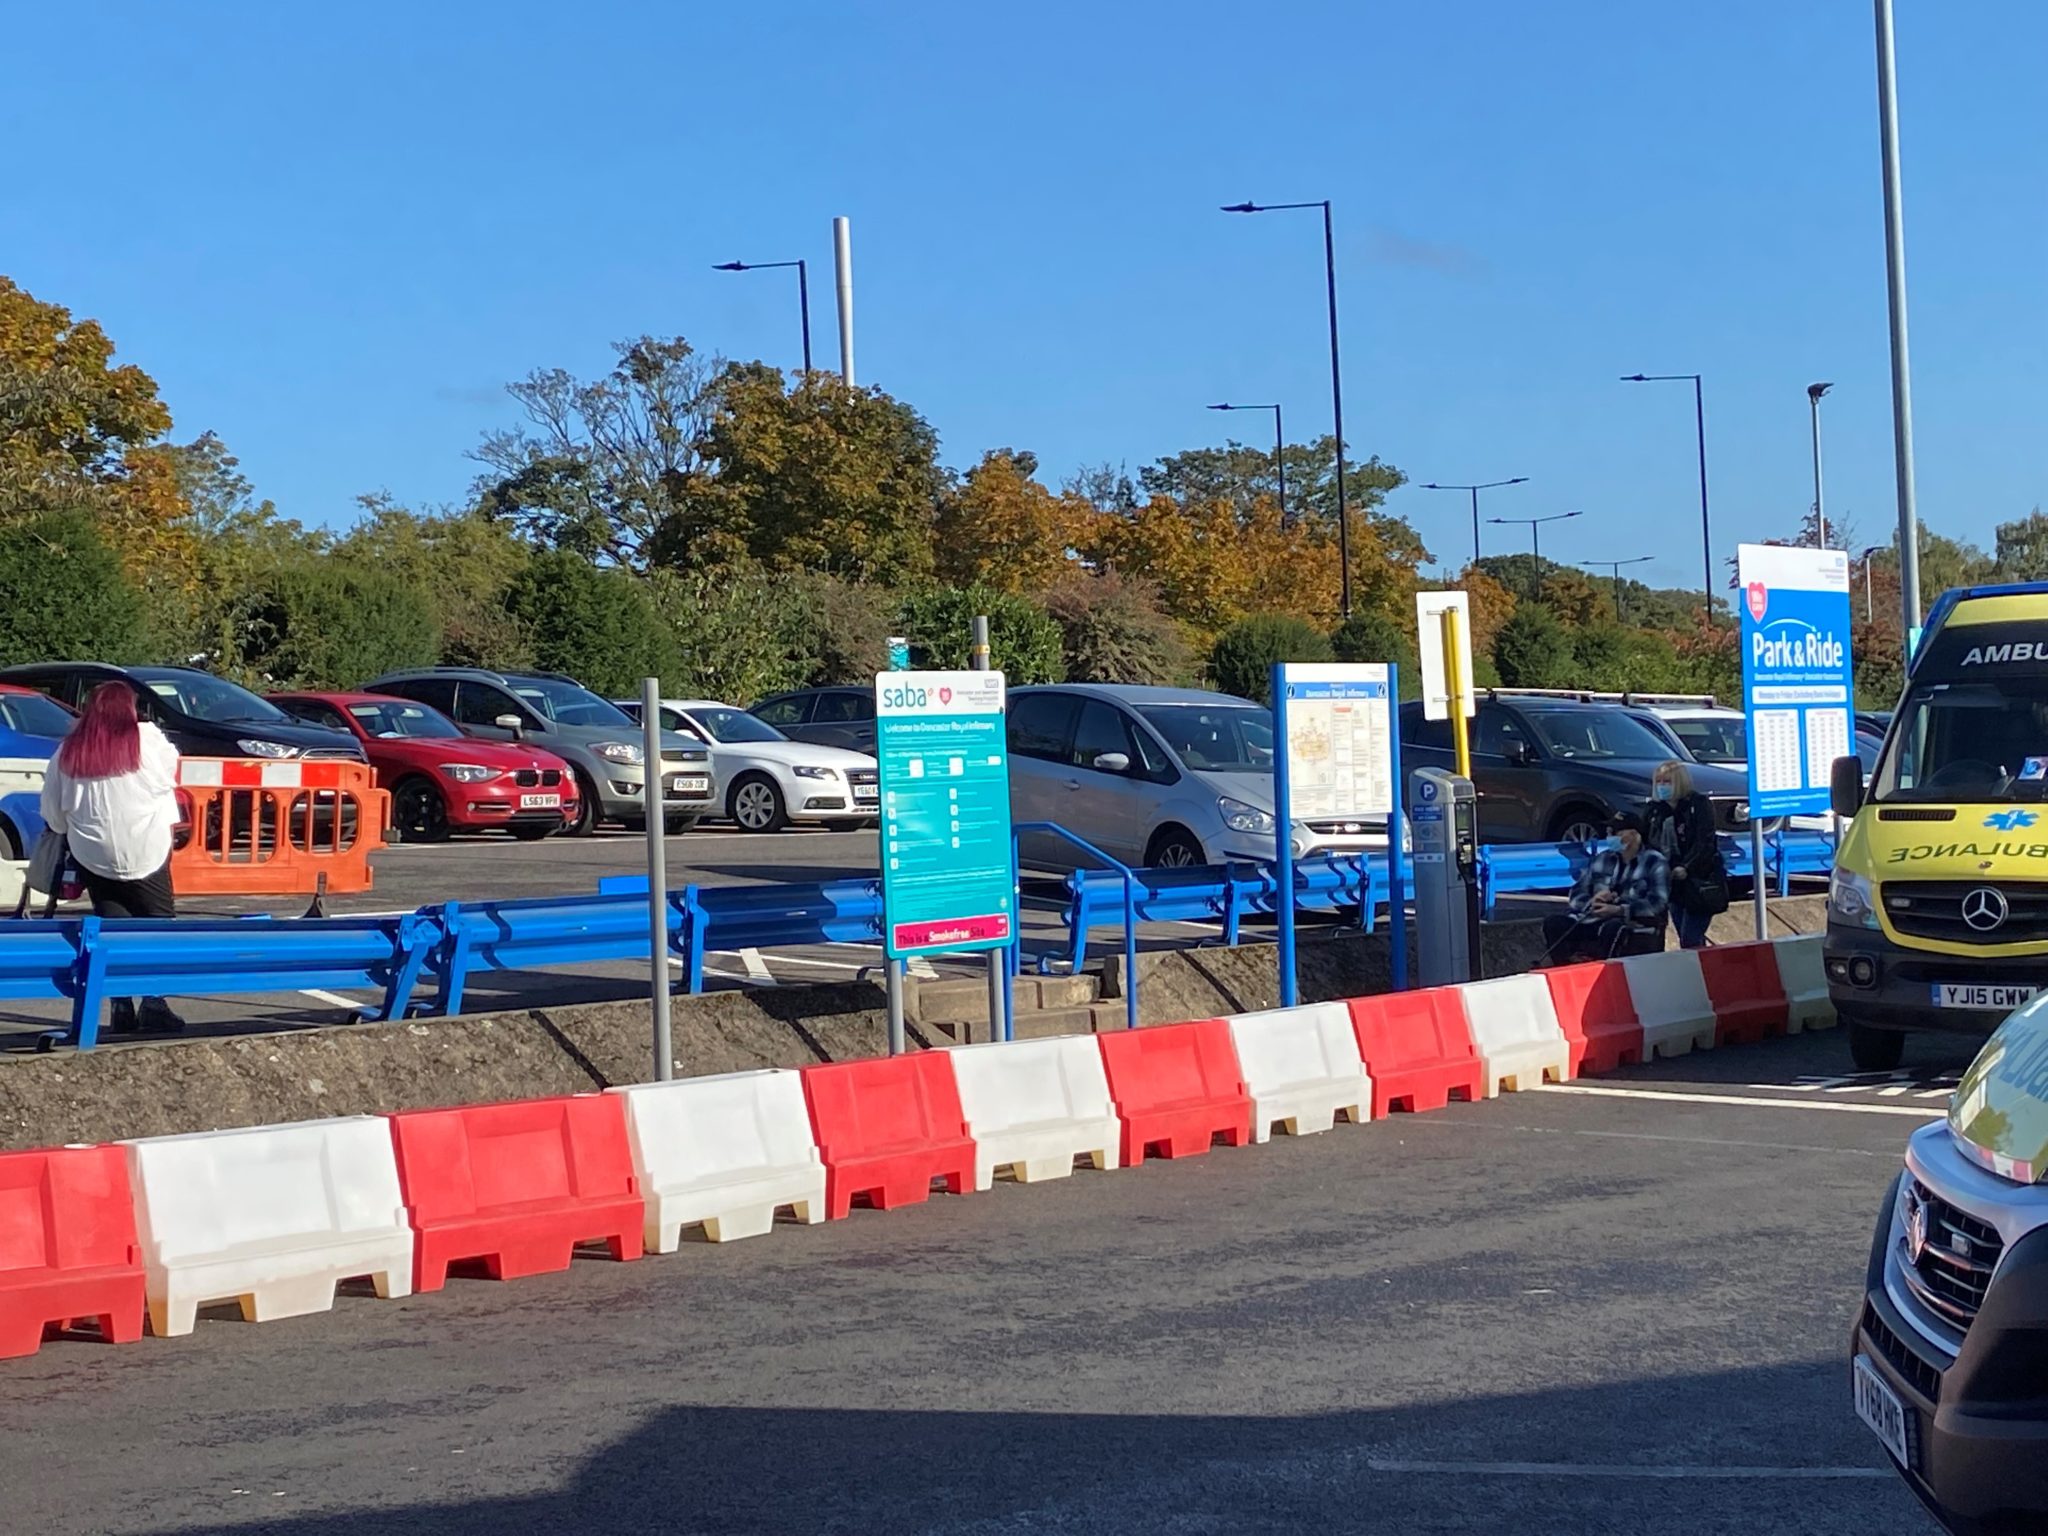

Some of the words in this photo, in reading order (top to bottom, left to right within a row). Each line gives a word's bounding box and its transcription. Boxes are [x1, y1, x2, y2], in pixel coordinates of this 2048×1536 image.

[883, 680, 927, 708] saba
[929, 928, 970, 942] Smokefree
[1947, 986, 1987, 1005] YJ15
